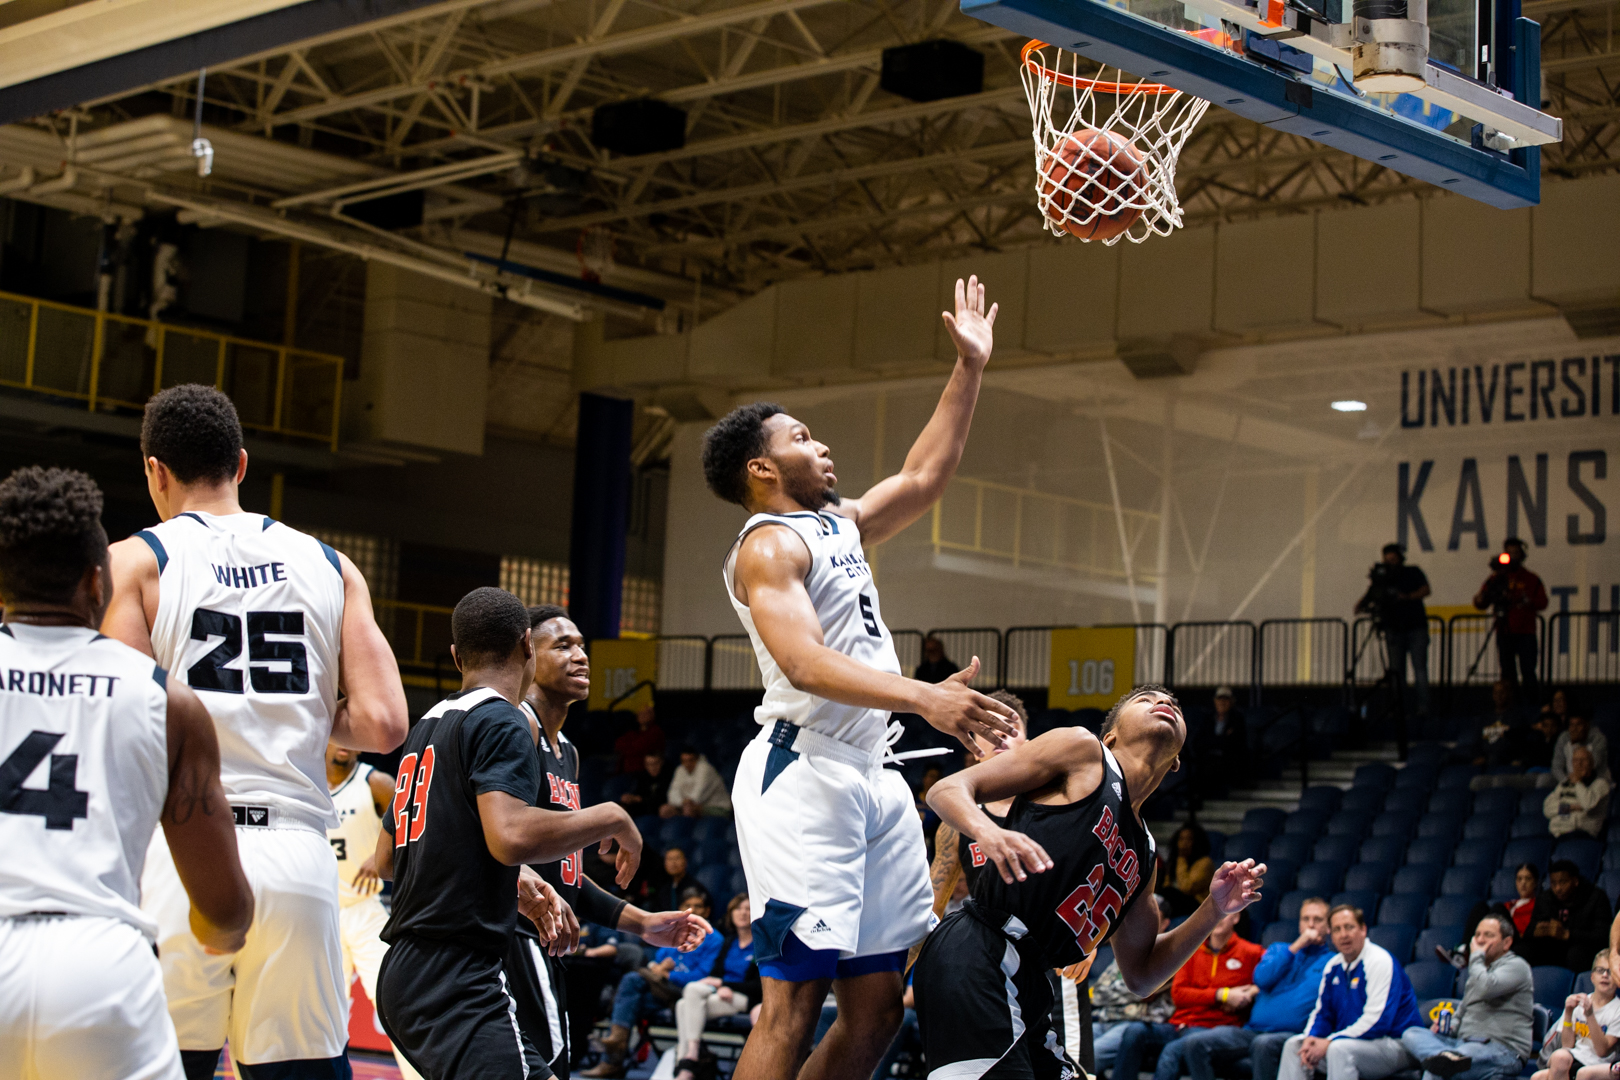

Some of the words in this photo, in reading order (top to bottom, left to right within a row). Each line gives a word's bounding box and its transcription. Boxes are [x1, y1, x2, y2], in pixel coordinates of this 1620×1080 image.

[1396, 450, 1607, 552] KANS
[211, 562, 287, 588] WHITE
[858, 593, 882, 638] 5
[0, 668, 121, 698] RONETT
[187, 607, 310, 694] 25
[1067, 659, 1115, 695] 106
[0, 730, 89, 830] 4
[393, 744, 436, 849] 23
